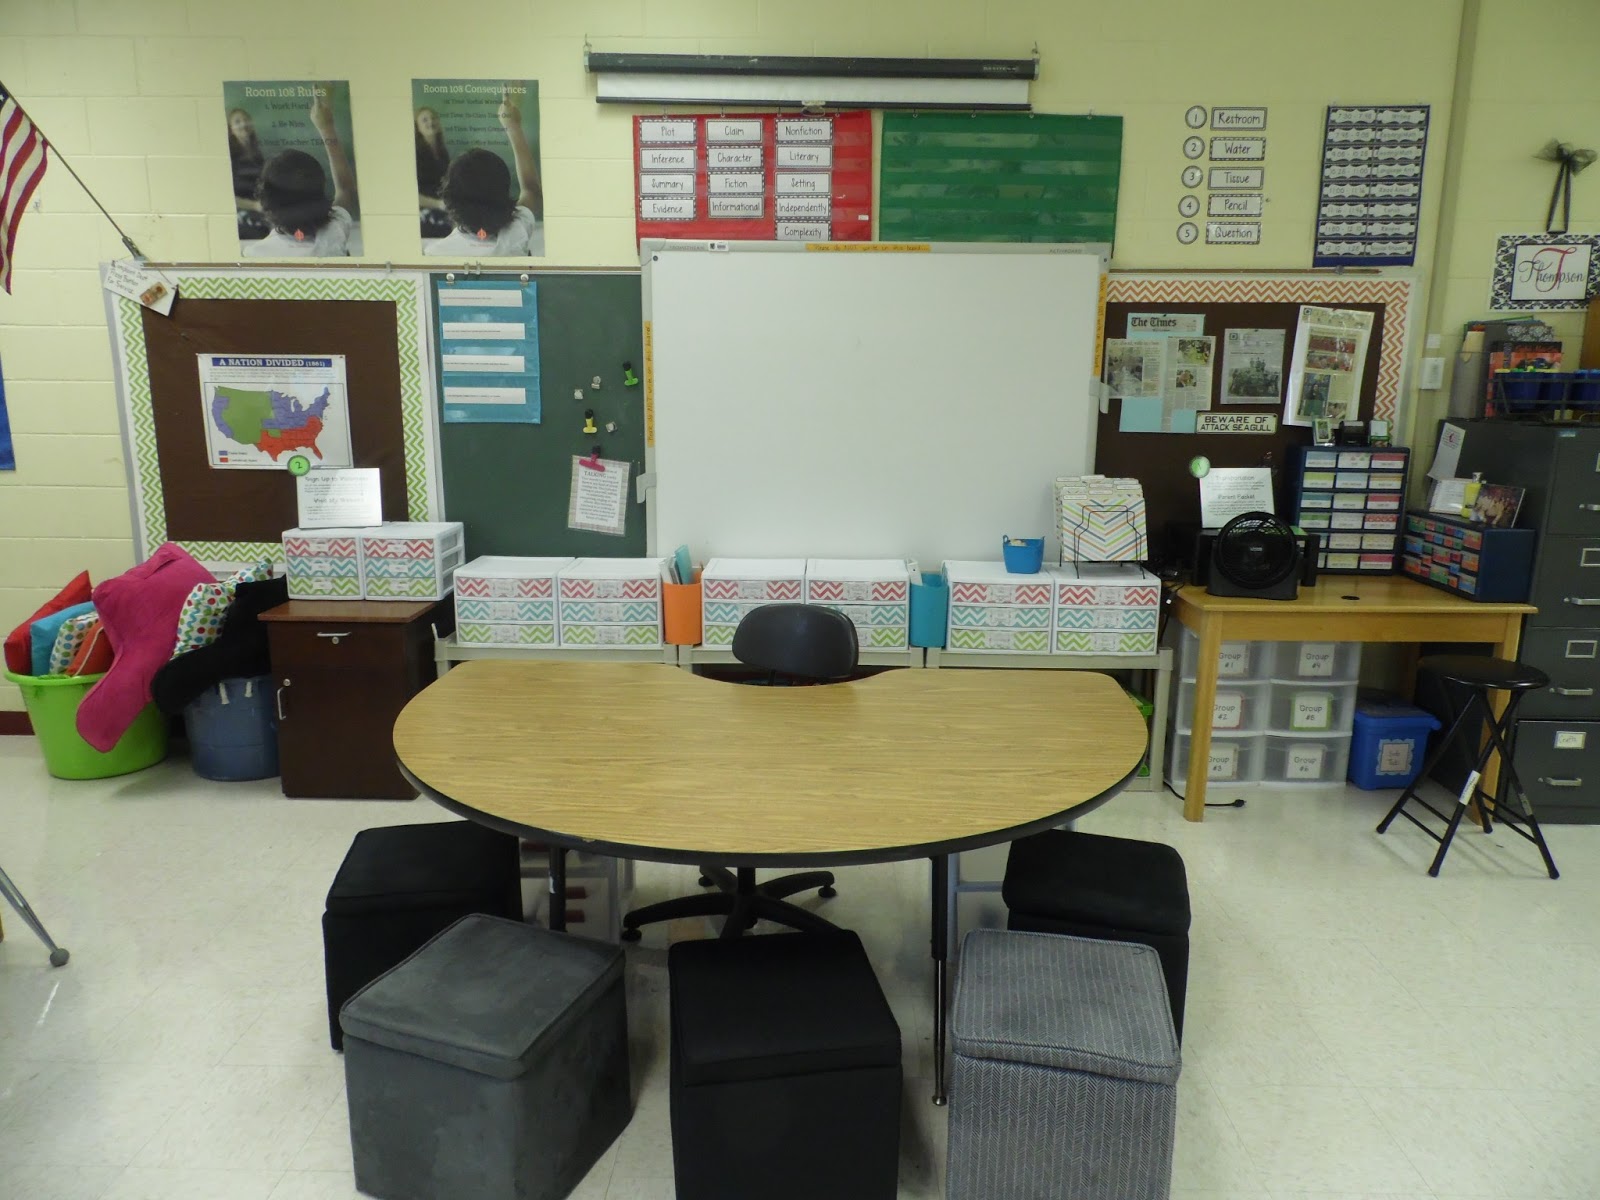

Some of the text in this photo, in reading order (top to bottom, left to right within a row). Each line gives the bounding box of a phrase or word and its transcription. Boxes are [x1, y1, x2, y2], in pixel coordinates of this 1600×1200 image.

[246, 86, 328, 98] Room 108 Rules
[423, 84, 527, 96] Room 108 Consequences
[1193, 113, 1198, 123] 1
[1218, 112, 1261, 124] Restroom
[661, 125, 676, 137] Plot
[724, 124, 745, 136] Claim
[785, 125, 823, 136] Nonfiction
[1191, 143, 1197, 152] 2
[1224, 143, 1251, 154] Water
[651, 154, 685, 164] Inference
[717, 151, 753, 162] Character
[789, 149, 819, 162] Literary
[724, 176, 749, 188] Fiction
[1189, 172, 1195, 181] 3
[1224, 171, 1250, 184] Tissue
[651, 177, 684, 190] Summary
[791, 176, 816, 191] Setting
[652, 202, 683, 214] Evidence
[711, 200, 760, 212] Informational
[779, 200, 827, 216] Independently
[1186, 202, 1192, 210] 4
[1224, 198, 1248, 211] Pencil
[784, 227, 822, 240] Complexity
[1184, 230, 1190, 238] 5
[1215, 226, 1253, 239] Question
[1518, 260, 1586, 291] Thompson
[1130, 316, 1148, 327] The
[1150, 317, 1176, 327] Times
[220, 358, 227, 366] A
[228, 358, 264, 367] NATION
[266, 359, 304, 368] DIVIDED
[1204, 416, 1250, 424] BEWARE
[1232, 424, 1272, 432] SEAGULL
[295, 461, 303, 469] 2
[584, 470, 608, 479] TALKING
[1219, 653, 1242, 662] Group
[1306, 653, 1330, 662] Group
[1213, 704, 1236, 713] Group
[1299, 704, 1323, 713] Group
[1208, 756, 1230, 764] Group
[1294, 756, 1316, 765] Group
